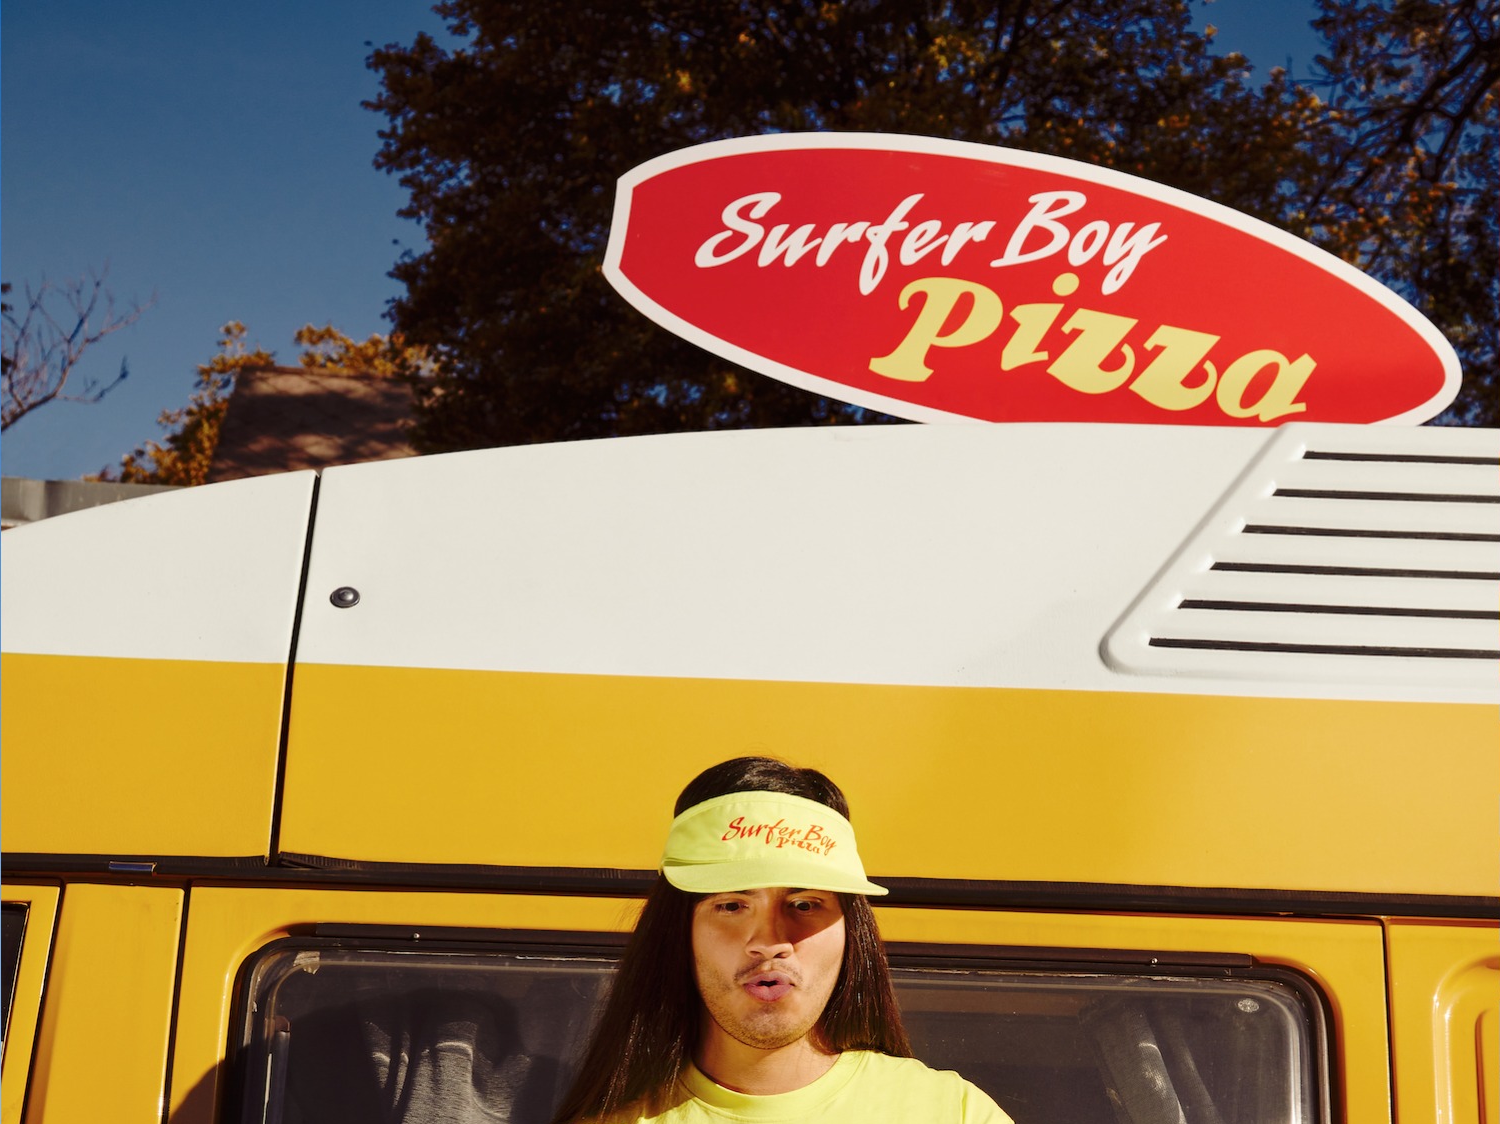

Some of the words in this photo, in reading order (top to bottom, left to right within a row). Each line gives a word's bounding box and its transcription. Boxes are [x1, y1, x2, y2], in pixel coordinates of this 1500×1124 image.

[695, 191, 995, 295] Surfer
[990, 190, 1167, 295] Boy
[722, 816, 802, 844] Surfer
[805, 824, 837, 856] Boy
